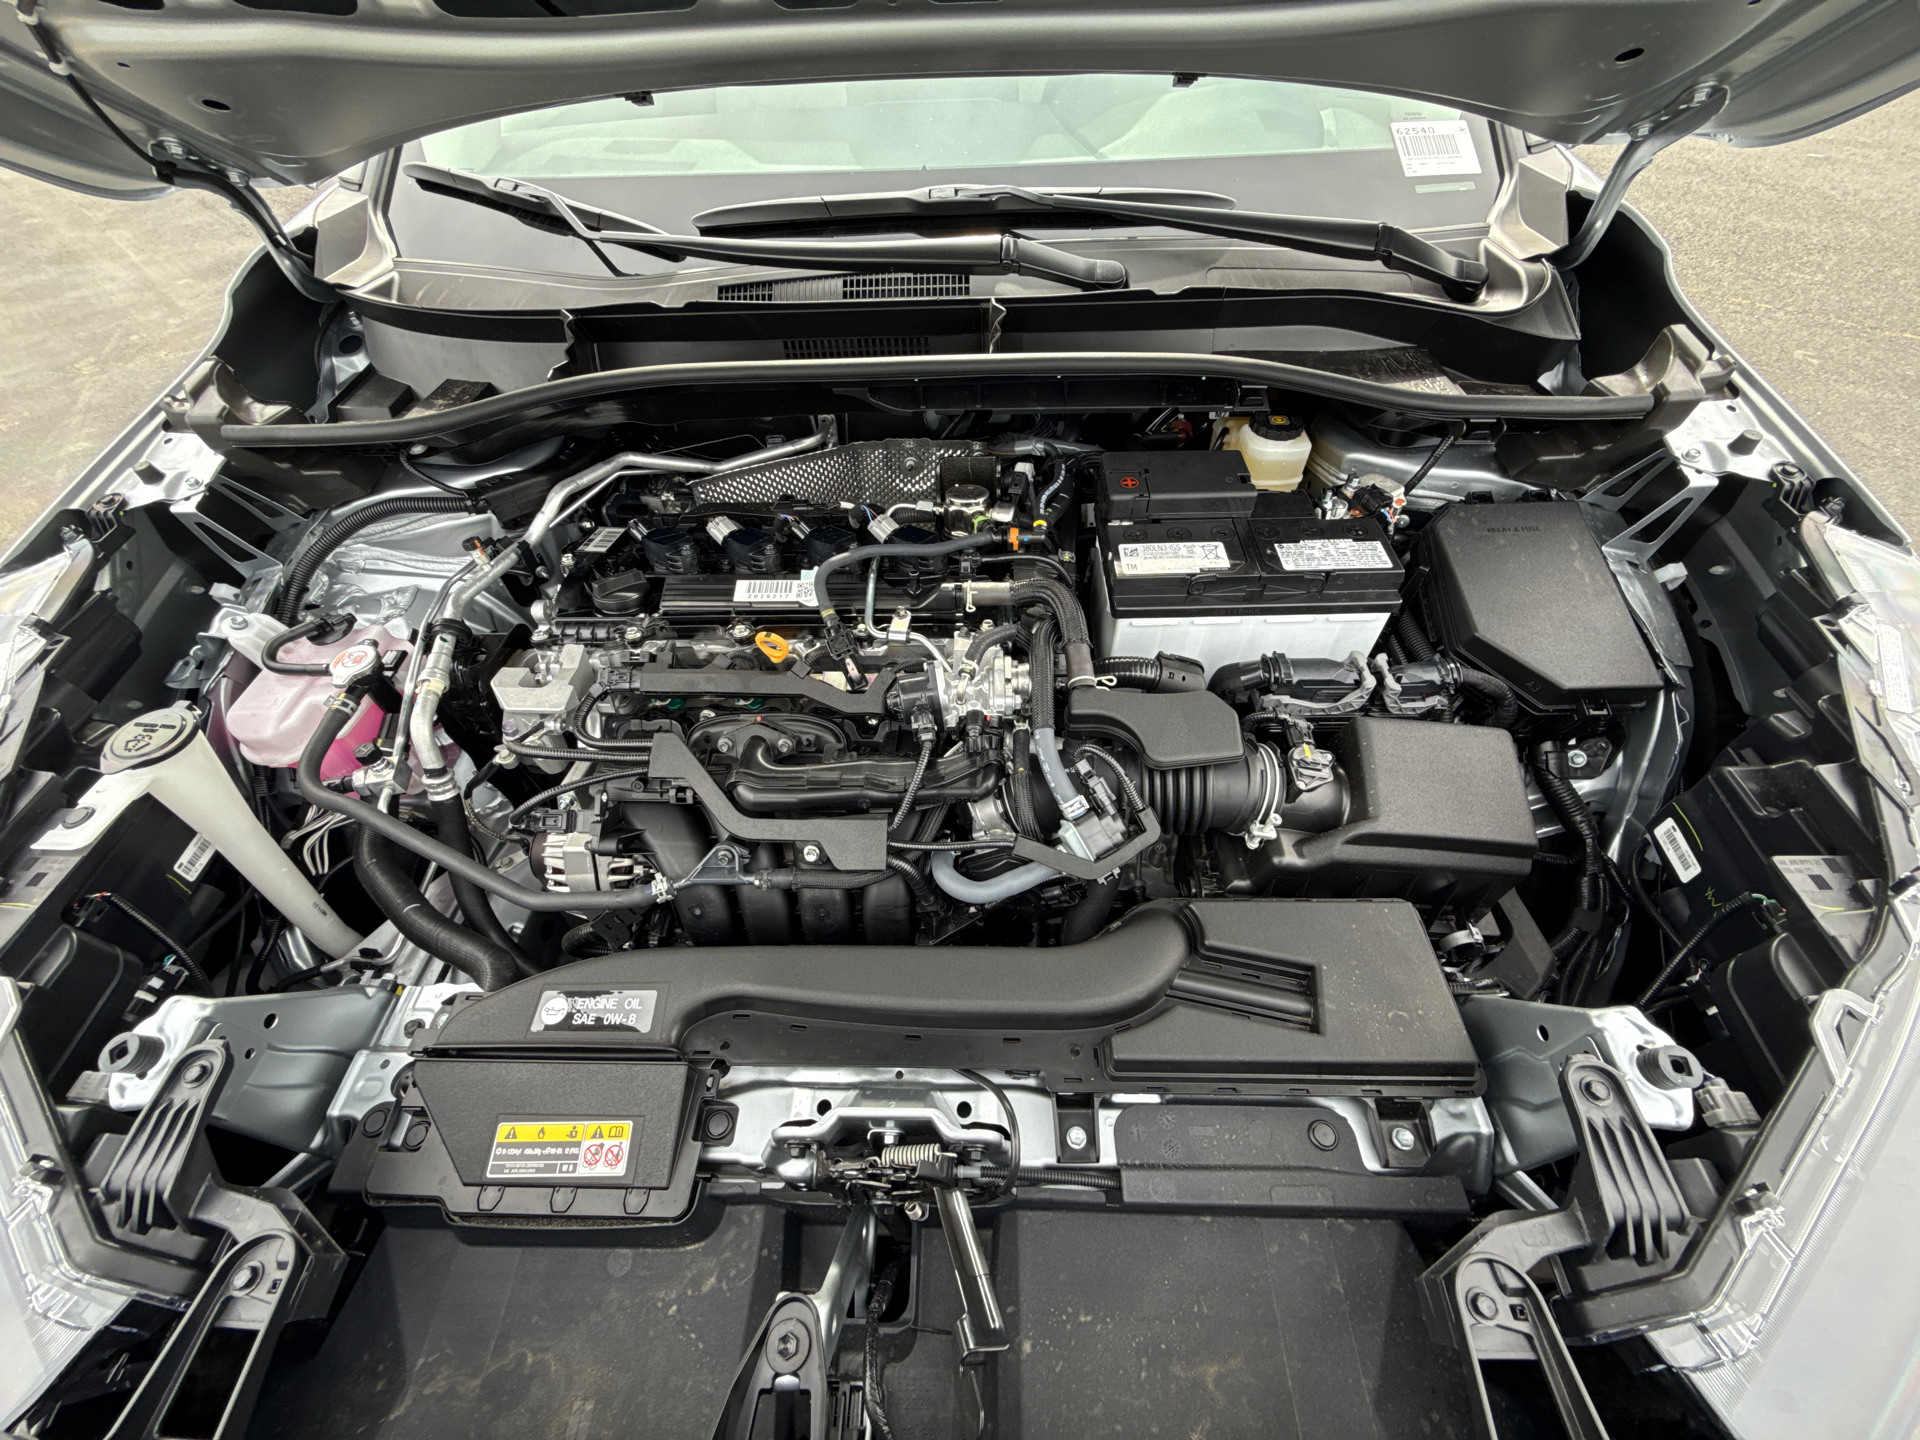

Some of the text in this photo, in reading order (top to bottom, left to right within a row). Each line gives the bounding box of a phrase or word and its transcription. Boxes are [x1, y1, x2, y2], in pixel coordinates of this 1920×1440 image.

[1396, 126, 1435, 135] 62540
[1141, 544, 1181, 552] 380LN3-ISS
[1126, 563, 1138, 571] TM
[576, 998, 642, 1009] ENGINE OIL
[572, 1013, 636, 1025] SAE 0W-8
